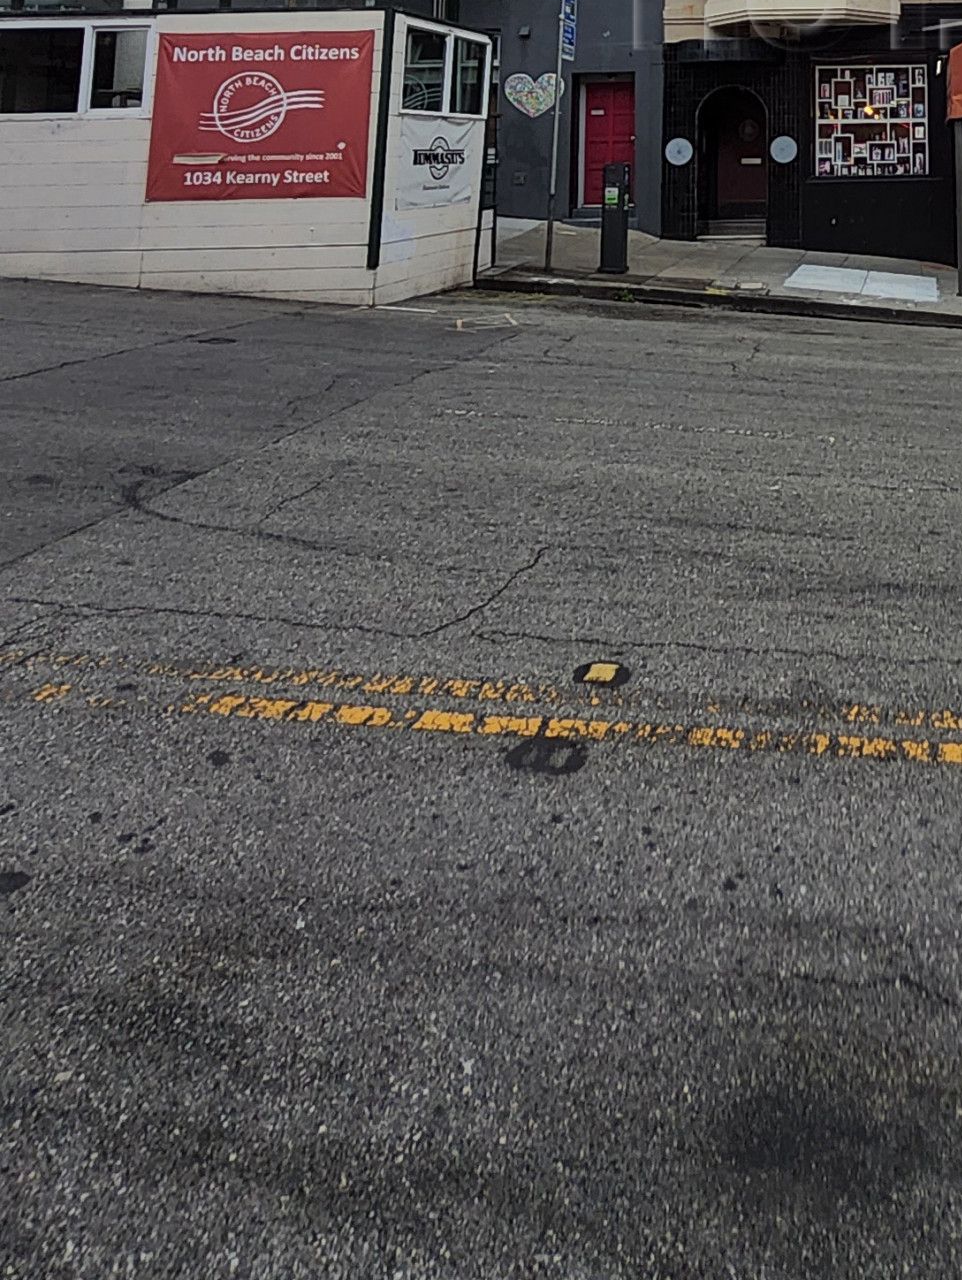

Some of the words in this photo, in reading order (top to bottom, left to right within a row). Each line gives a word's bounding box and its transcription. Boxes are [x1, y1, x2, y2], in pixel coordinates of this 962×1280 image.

[173, 46, 226, 62] North
[231, 45, 285, 61] Beach
[290, 44, 360, 60] Citizens
[220, 79, 243, 113] NORTH
[245, 76, 278, 96] BEACH
[233, 114, 279, 138] CITIZENS
[262, 153, 304, 162] community
[305, 152, 324, 161] since
[325, 152, 343, 160] 2001
[184, 171, 222, 185] 1034
[225, 170, 280, 186] Kearny
[283, 169, 330, 184] Street
